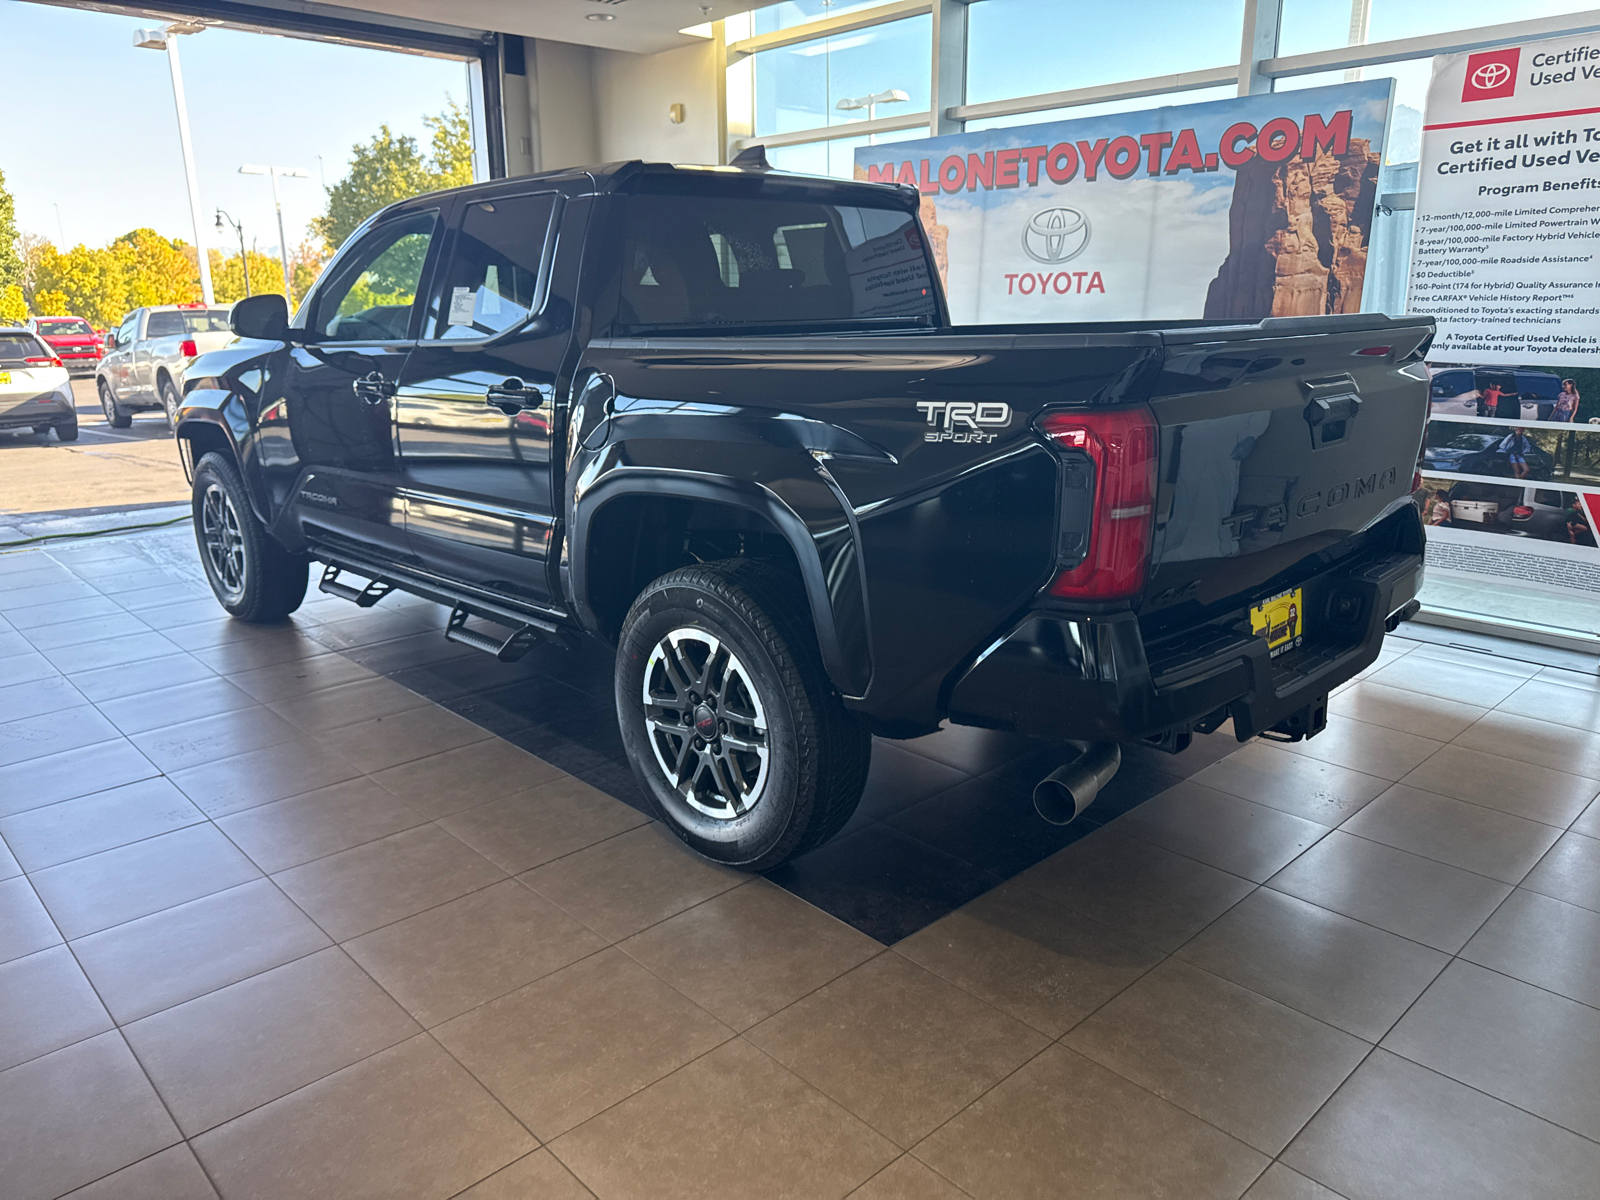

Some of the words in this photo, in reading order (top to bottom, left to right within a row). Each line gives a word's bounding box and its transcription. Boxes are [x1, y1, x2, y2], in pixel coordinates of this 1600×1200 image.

[1530, 66, 1576, 86] Used
[1450, 140, 1482, 154] Get
[1487, 138, 1500, 152] it
[1504, 134, 1528, 150] all
[1534, 130, 1578, 146] with
[868, 110, 1352, 197] MALONETOYOTA.COM
[1437, 155, 1517, 175] Certified
[1522, 150, 1571, 168] Used
[1478, 184, 1538, 197] Program
[1422, 210, 1512, 222] 12-month/12,000-mile
[1514, 207, 1547, 216] Limited
[1420, 222, 1503, 234] 7-year/100,000-mile
[1505, 220, 1537, 229] Limited
[1539, 218, 1588, 227] Powertrain
[1419, 234, 1500, 246] 8-year/100,000-mile
[1502, 234, 1533, 243] Factory
[1536, 232, 1565, 242] Hybrid
[1417, 256, 1498, 267] 7-year/100,000-mile
[1500, 256, 1540, 264] Roadside
[1004, 272, 1105, 295] TOYOTA
[1452, 282, 1469, 290] (174
[1484, 282, 1514, 291] Hybrid)
[1516, 282, 1547, 290] Quality
[1500, 294, 1531, 303] History
[1515, 307, 1553, 315] exacting
[1449, 316, 1510, 324] factory-trained
[1485, 334, 1525, 342] Certified
[1552, 335, 1587, 343] Vehicle
[1431, 342, 1450, 351] only
[1527, 344, 1557, 353] Toyota
[916, 401, 1013, 433] TRD
[924, 432, 998, 443] SPORT
[300, 490, 338, 506] TACOMA
[1222, 466, 1396, 540] TACOMA
